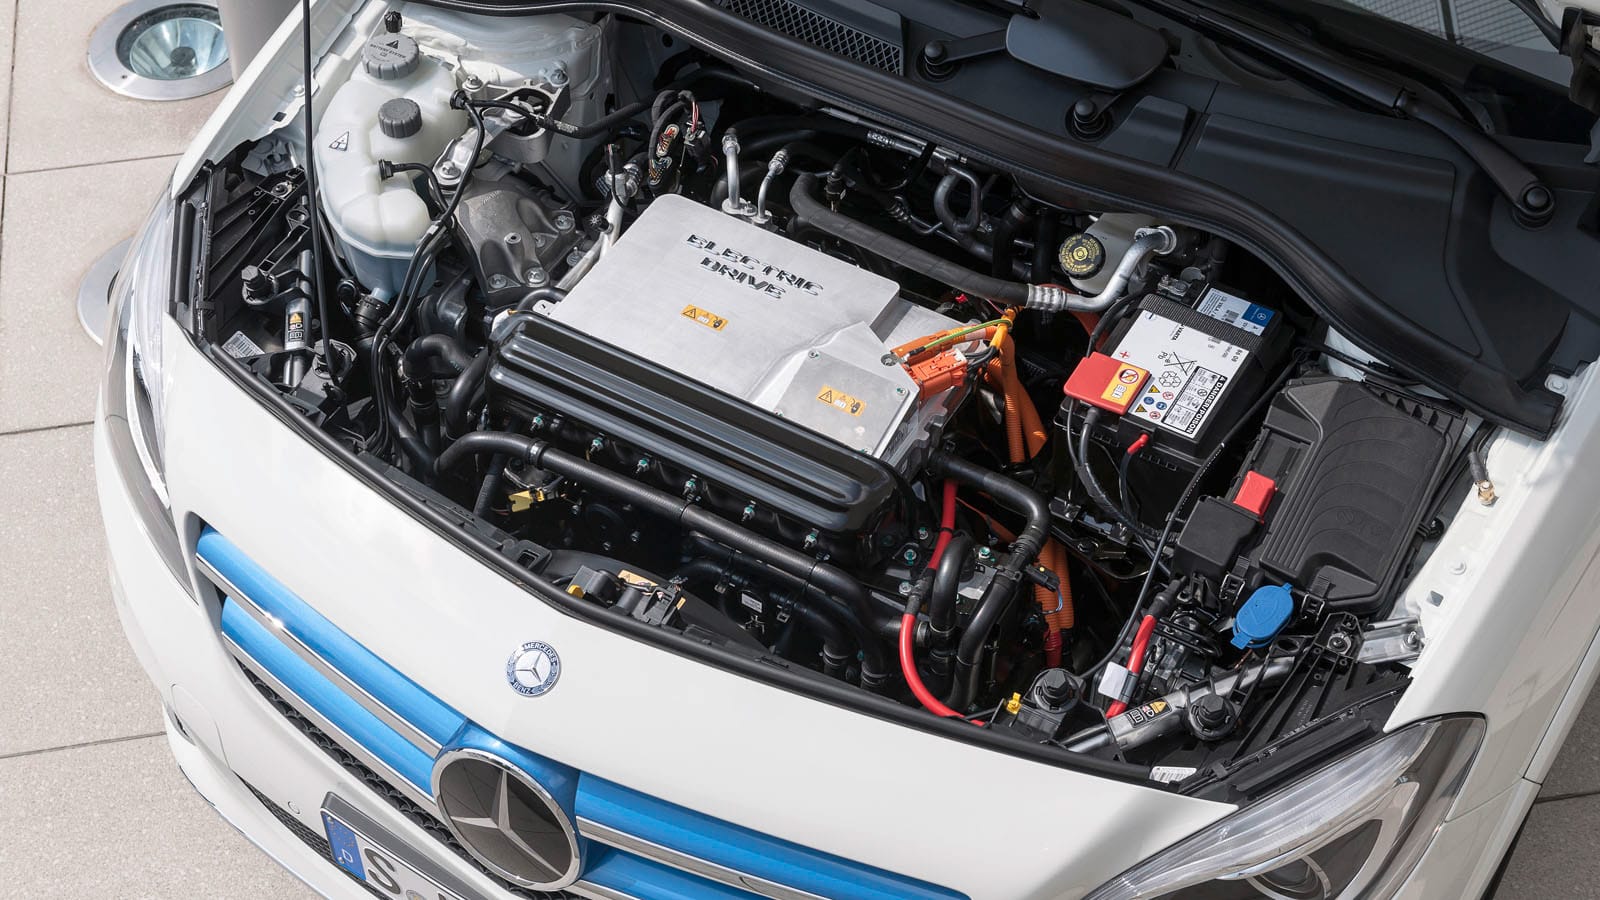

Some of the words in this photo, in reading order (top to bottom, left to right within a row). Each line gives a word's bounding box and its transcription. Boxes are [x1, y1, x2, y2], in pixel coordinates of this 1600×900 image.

[687, 234, 824, 296] ELECTRIC
[700, 257, 786, 299] DRIVE
[1171, 325, 1184, 341] VARTA
[1157, 351, 1168, 360] Pb
[1186, 382, 1223, 434] DANGER/POISON
[523, 643, 557, 662] MERCEDES
[513, 682, 532, 694] BENZ
[342, 849, 353, 863] D
[364, 848, 400, 894] S
